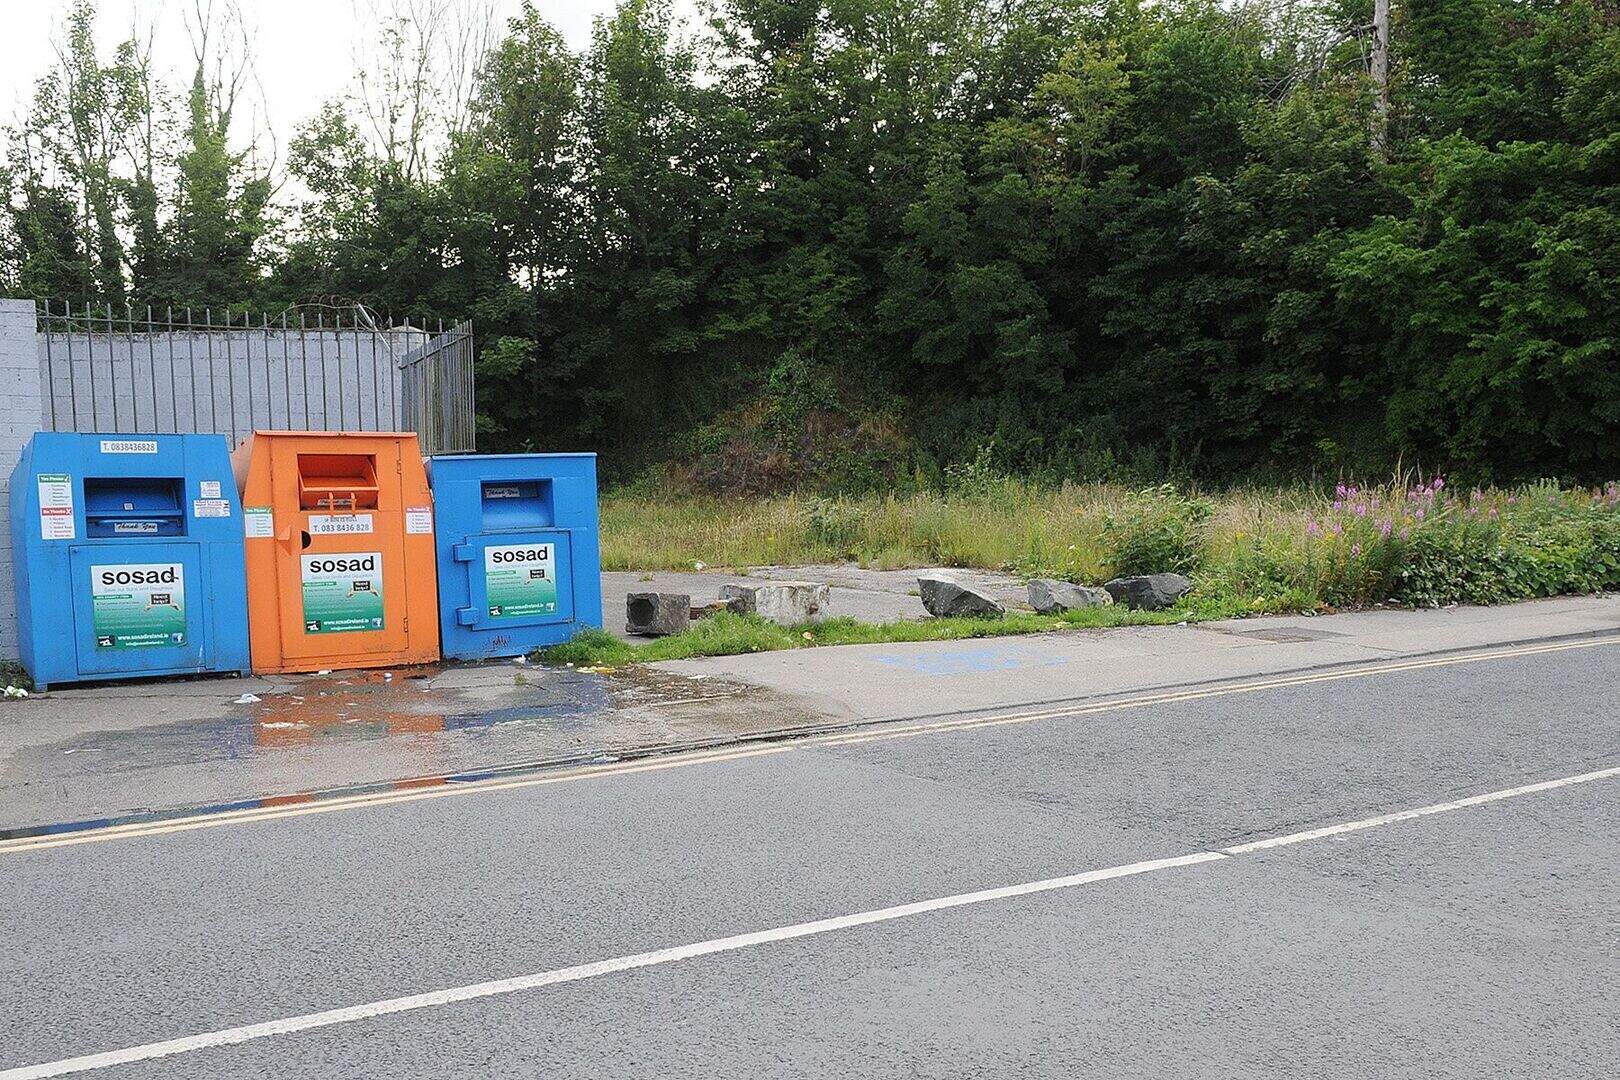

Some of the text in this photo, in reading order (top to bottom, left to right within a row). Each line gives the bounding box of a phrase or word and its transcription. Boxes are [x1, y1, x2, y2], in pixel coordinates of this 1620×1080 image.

[110, 442, 155, 451] 0838436828
[336, 524, 355, 532] 8436
[492, 546, 548, 563] sosad
[309, 555, 375, 573] sosad
[102, 567, 176, 585] sosad
